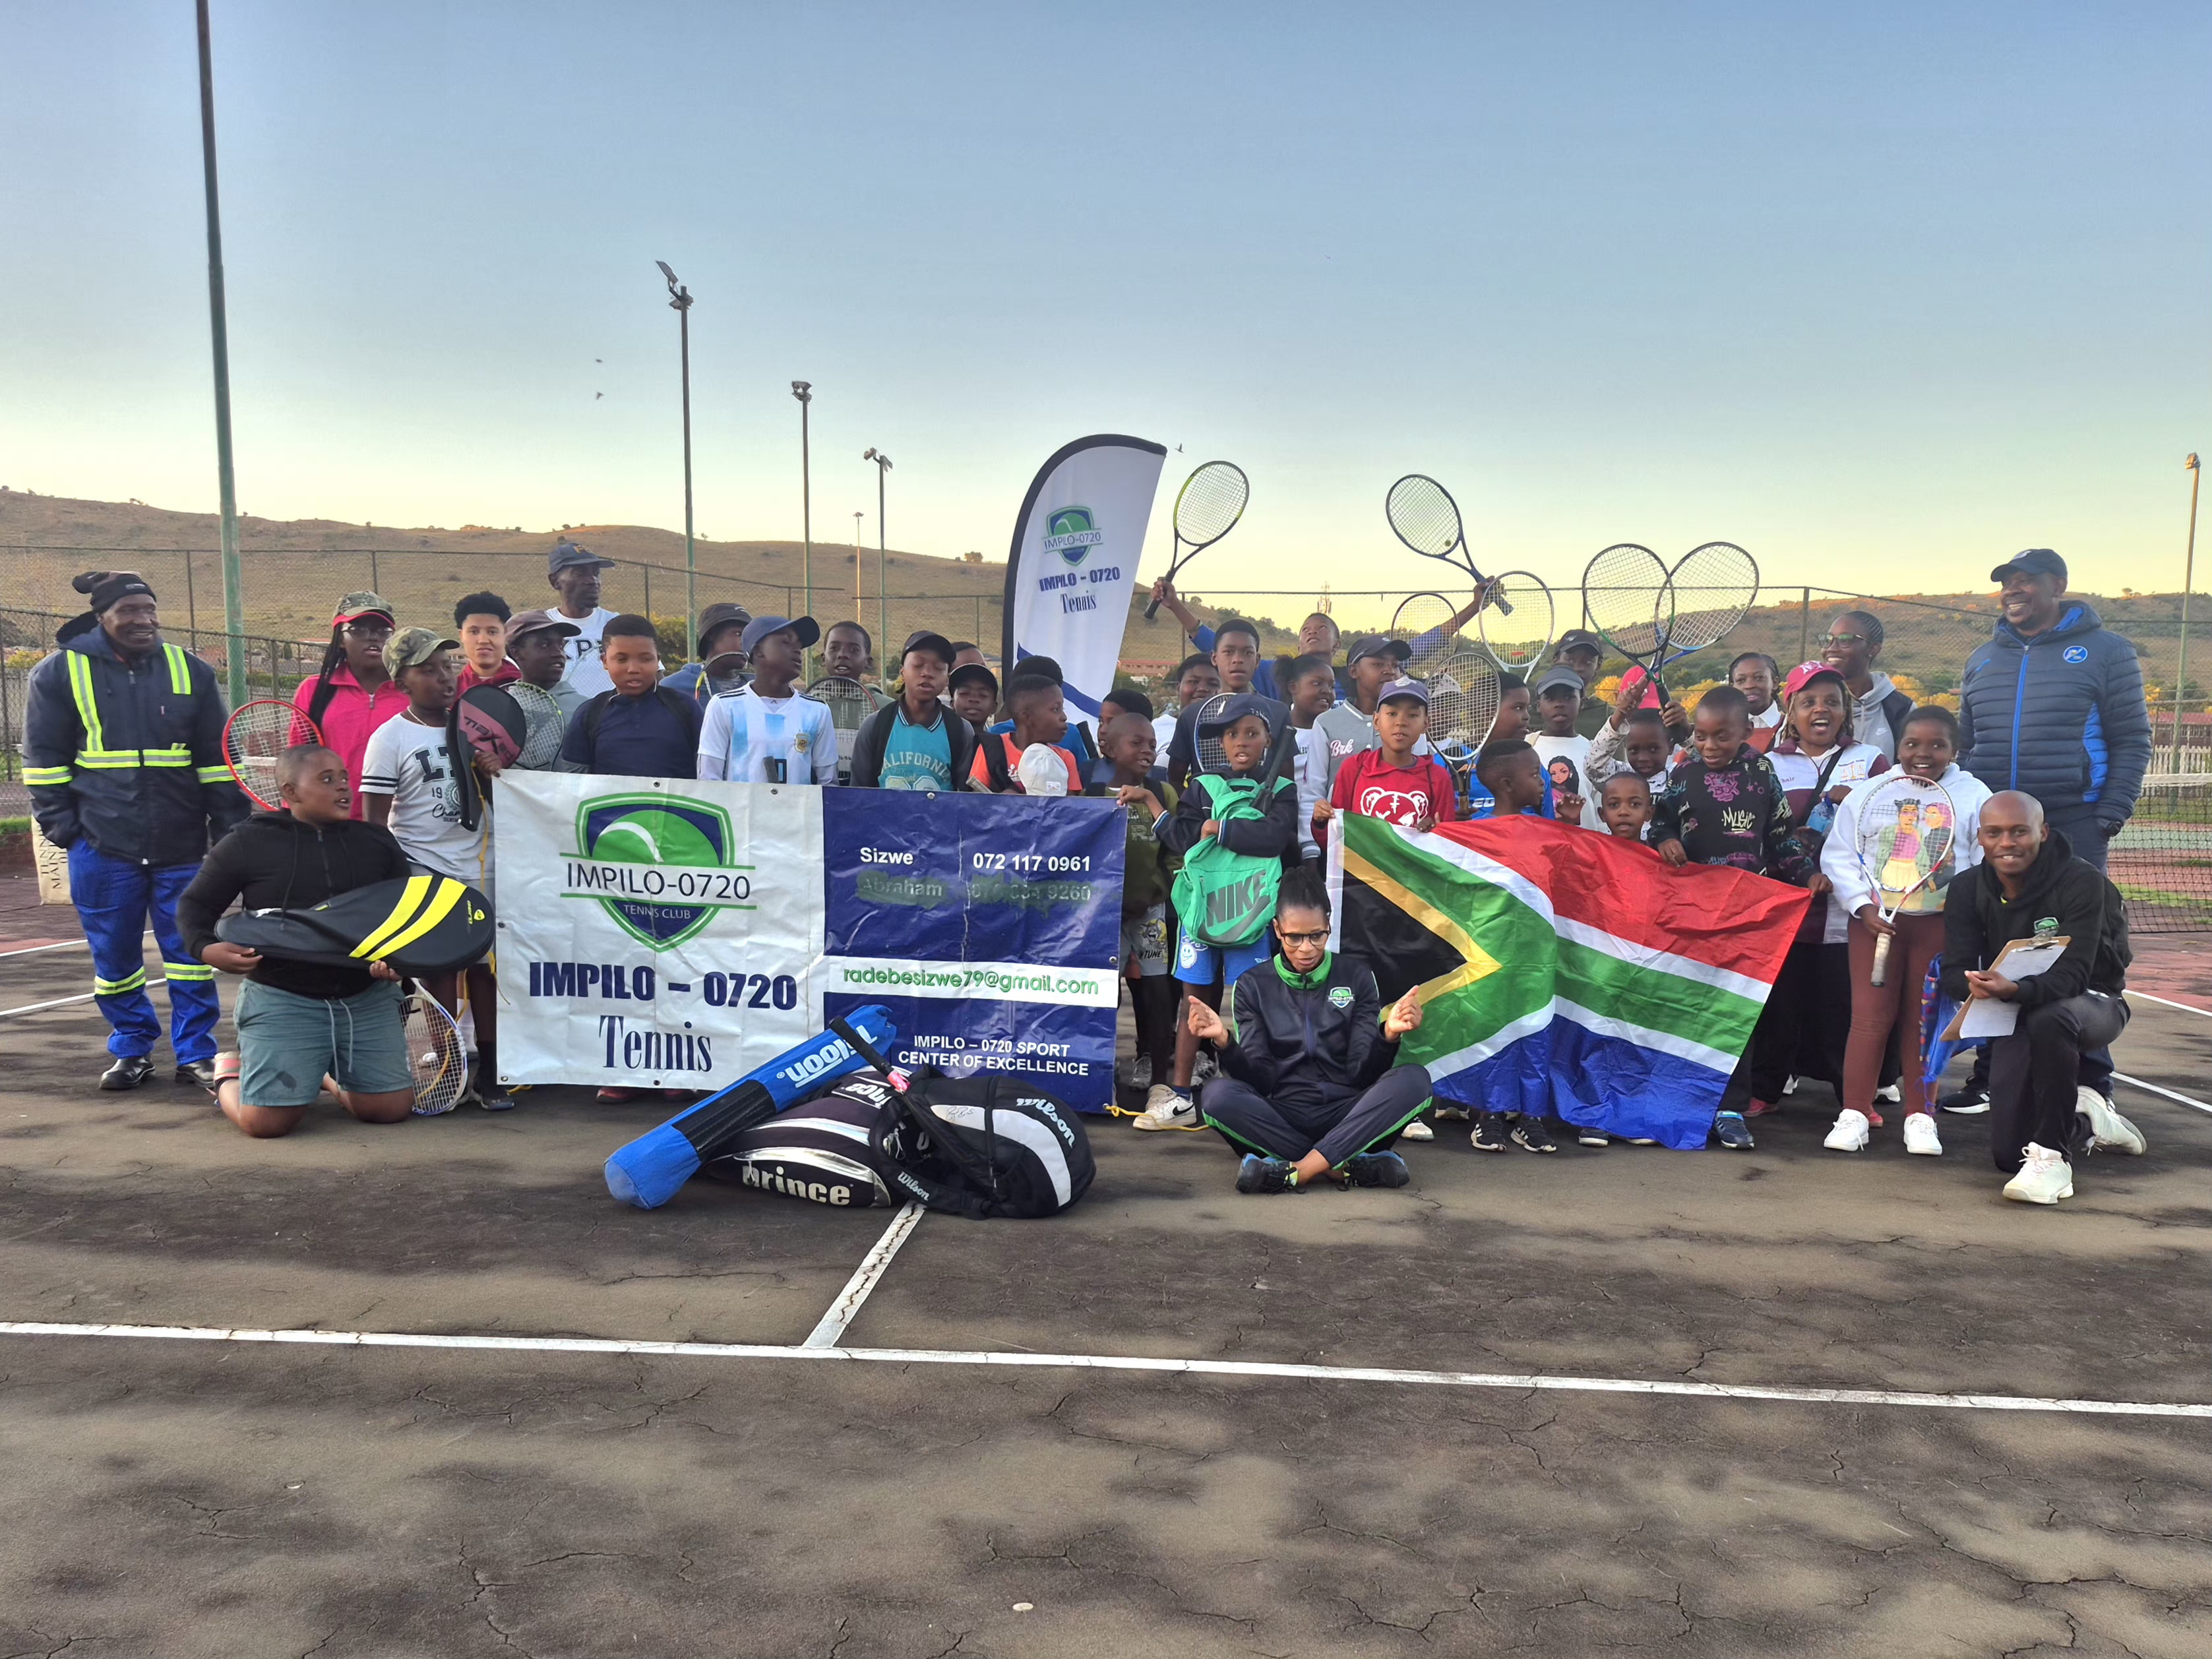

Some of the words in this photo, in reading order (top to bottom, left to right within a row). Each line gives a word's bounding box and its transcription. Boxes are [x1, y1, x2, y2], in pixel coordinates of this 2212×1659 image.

[1090, 566, 1121, 584] 0720
[1060, 589, 1097, 614] Tennis
[1330, 739, 1353, 757] Brk
[860, 847, 913, 865] Sizwe
[973, 853, 1006, 870] 072
[1012, 855, 1043, 871] 117
[1048, 855, 1090, 872] 0961
[567, 862, 751, 900] IMPILO-0720
[623, 904, 660, 919] TENNIS
[661, 908, 691, 920] CLUB
[529, 962, 656, 1001] IMPILO
[703, 971, 797, 1010] 0720
[844, 967, 1099, 994] radebesizwe79@gmail.com
[599, 1015, 713, 1073] Tennis
[914, 1035, 965, 1050] IMPILO
[981, 1040, 1012, 1054] 0720
[1016, 1042, 1070, 1058] SPORT
[898, 1050, 963, 1067] CENTER
[966, 1056, 982, 1068] OF
[987, 1056, 1089, 1076] EXCELLENCE
[1016, 1098, 1075, 1149] Wilson
[897, 1171, 930, 1201] Wilson
